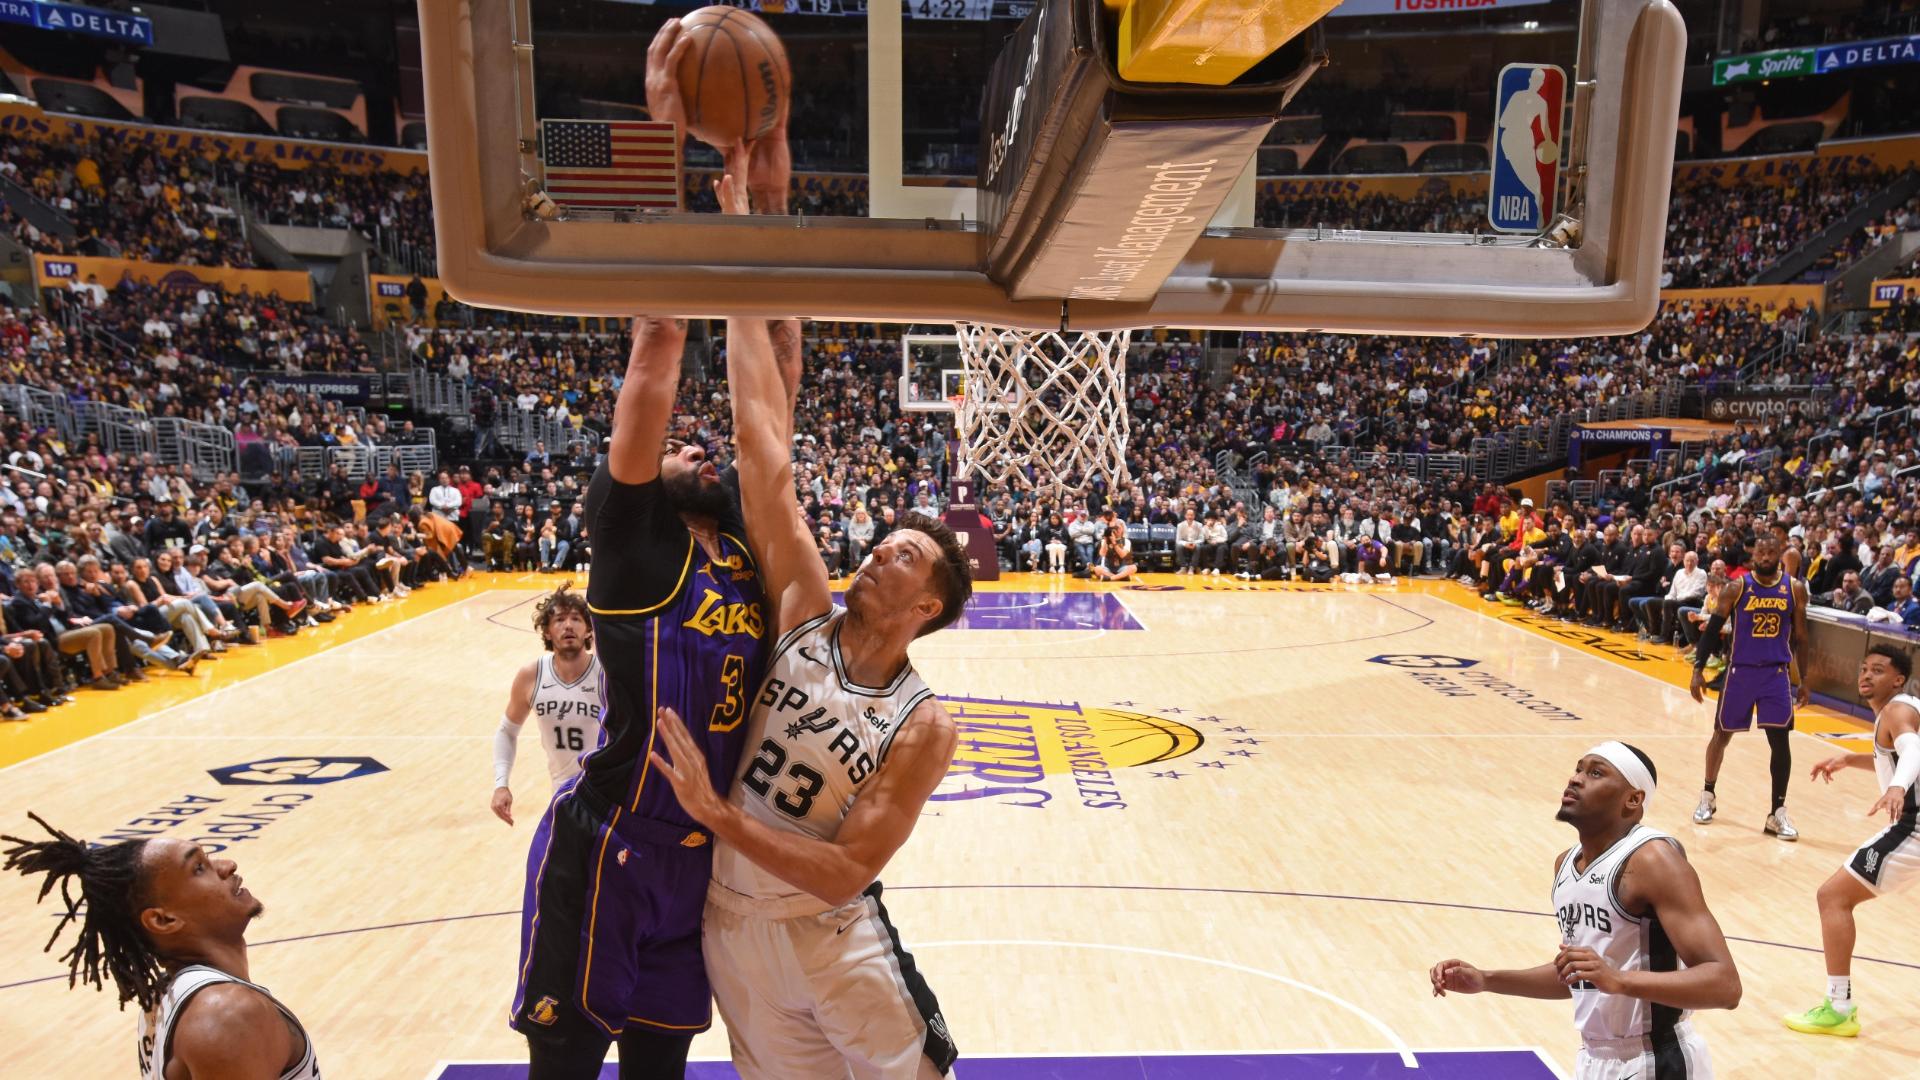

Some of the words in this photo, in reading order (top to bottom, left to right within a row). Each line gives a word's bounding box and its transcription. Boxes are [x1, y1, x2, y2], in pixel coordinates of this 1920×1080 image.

[0, 2, 31, 18] TRA
[918, 0, 967, 18] 4:22
[1008, 5, 1032, 16] Spu
[71, 12, 145, 38] DELTA
[1845, 42, 1916, 65] DELTA
[1758, 54, 1804, 77] Sprite
[1264, 180, 1363, 199] AKERS
[1093, 159, 1218, 258] Management
[1498, 195, 1531, 221] NBA
[381, 284, 401, 296] 115
[1879, 286, 1899, 299] 117
[309, 383, 360, 395] EXPRESS
[1581, 430, 1595, 440] 17x
[1596, 430, 1651, 442] CHAMPIONS
[1744, 595, 1788, 611] LAKERS
[1752, 612, 1781, 638] 23
[708, 654, 745, 733] 3
[536, 700, 601, 720] SPURS
[863, 706, 891, 735] Self.
[554, 726, 584, 750] 16
[760, 678, 876, 785] SPURS
[1054, 717, 1096, 740] LOS
[742, 736, 827, 820] 23
[1062, 739, 1128, 810] ANGELES
